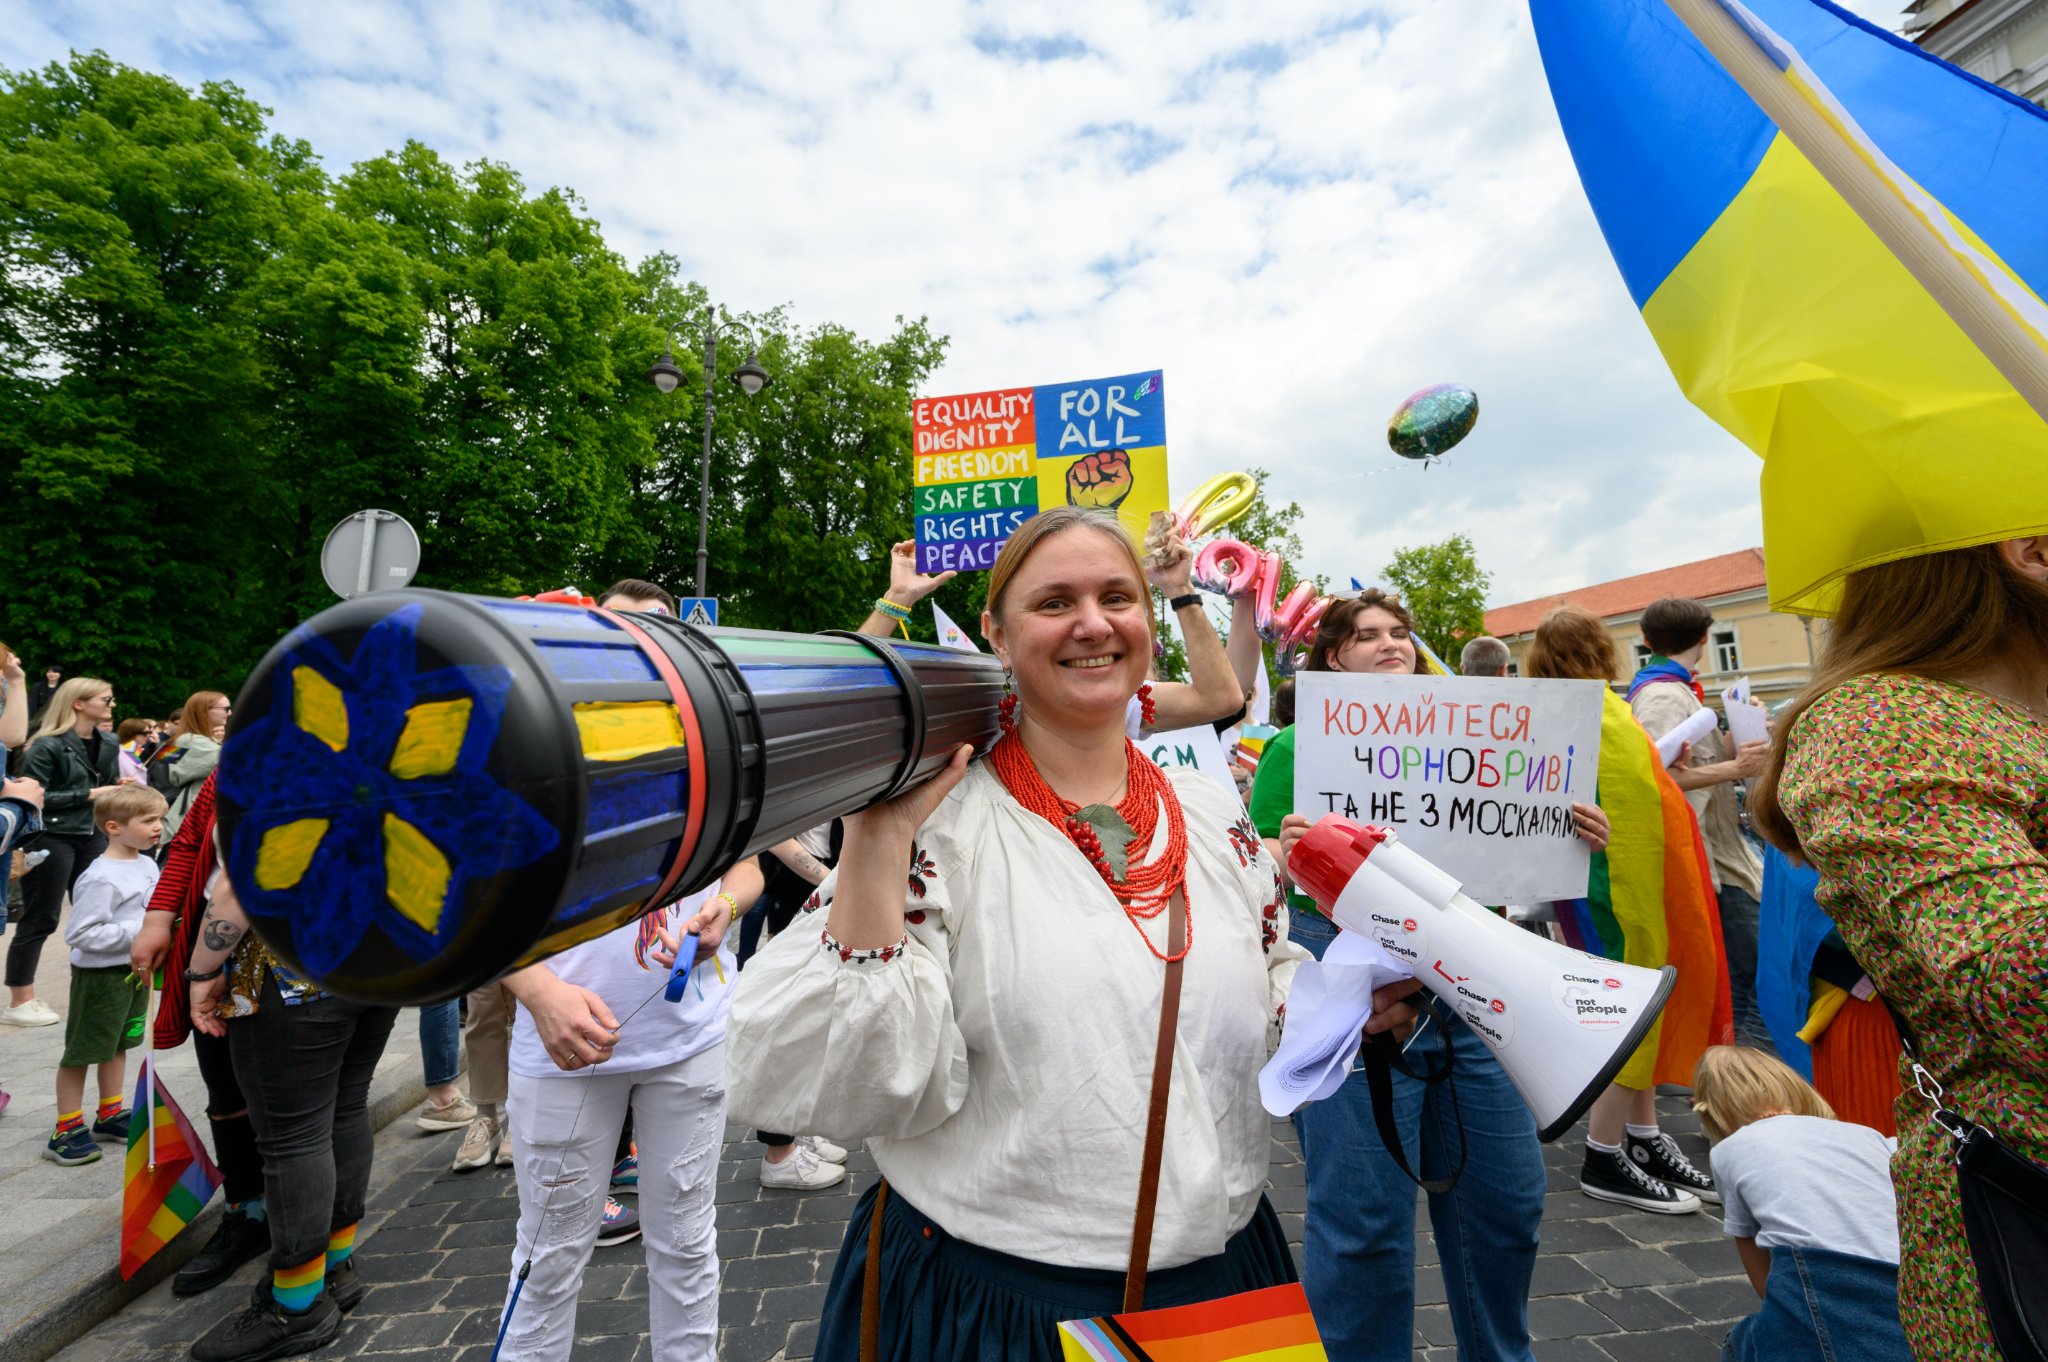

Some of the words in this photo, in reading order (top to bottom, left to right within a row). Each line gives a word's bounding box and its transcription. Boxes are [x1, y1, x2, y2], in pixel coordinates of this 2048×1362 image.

[1060, 385, 1142, 421] FOR
[1059, 416, 1141, 450] ALL
[918, 448, 1029, 483] FREEDOM
[921, 480, 1024, 512] SAFETY
[1324, 692, 1536, 747] КОХАЙТЕСЯ,
[1319, 791, 1359, 819] ТА
[1371, 790, 1408, 823] НЕ
[1449, 797, 1583, 840] МОСКАЛЯМ
[1371, 913, 1400, 926] Chase
[1380, 937, 1396, 946] not
[1382, 942, 1418, 958] people
[1563, 974, 1600, 985] Chase
[1457, 986, 1488, 1004] Chase
[1575, 998, 1597, 1006] not
[1465, 1010, 1481, 1022] not
[1577, 1005, 1628, 1015] people
[1466, 1015, 1503, 1042] people
